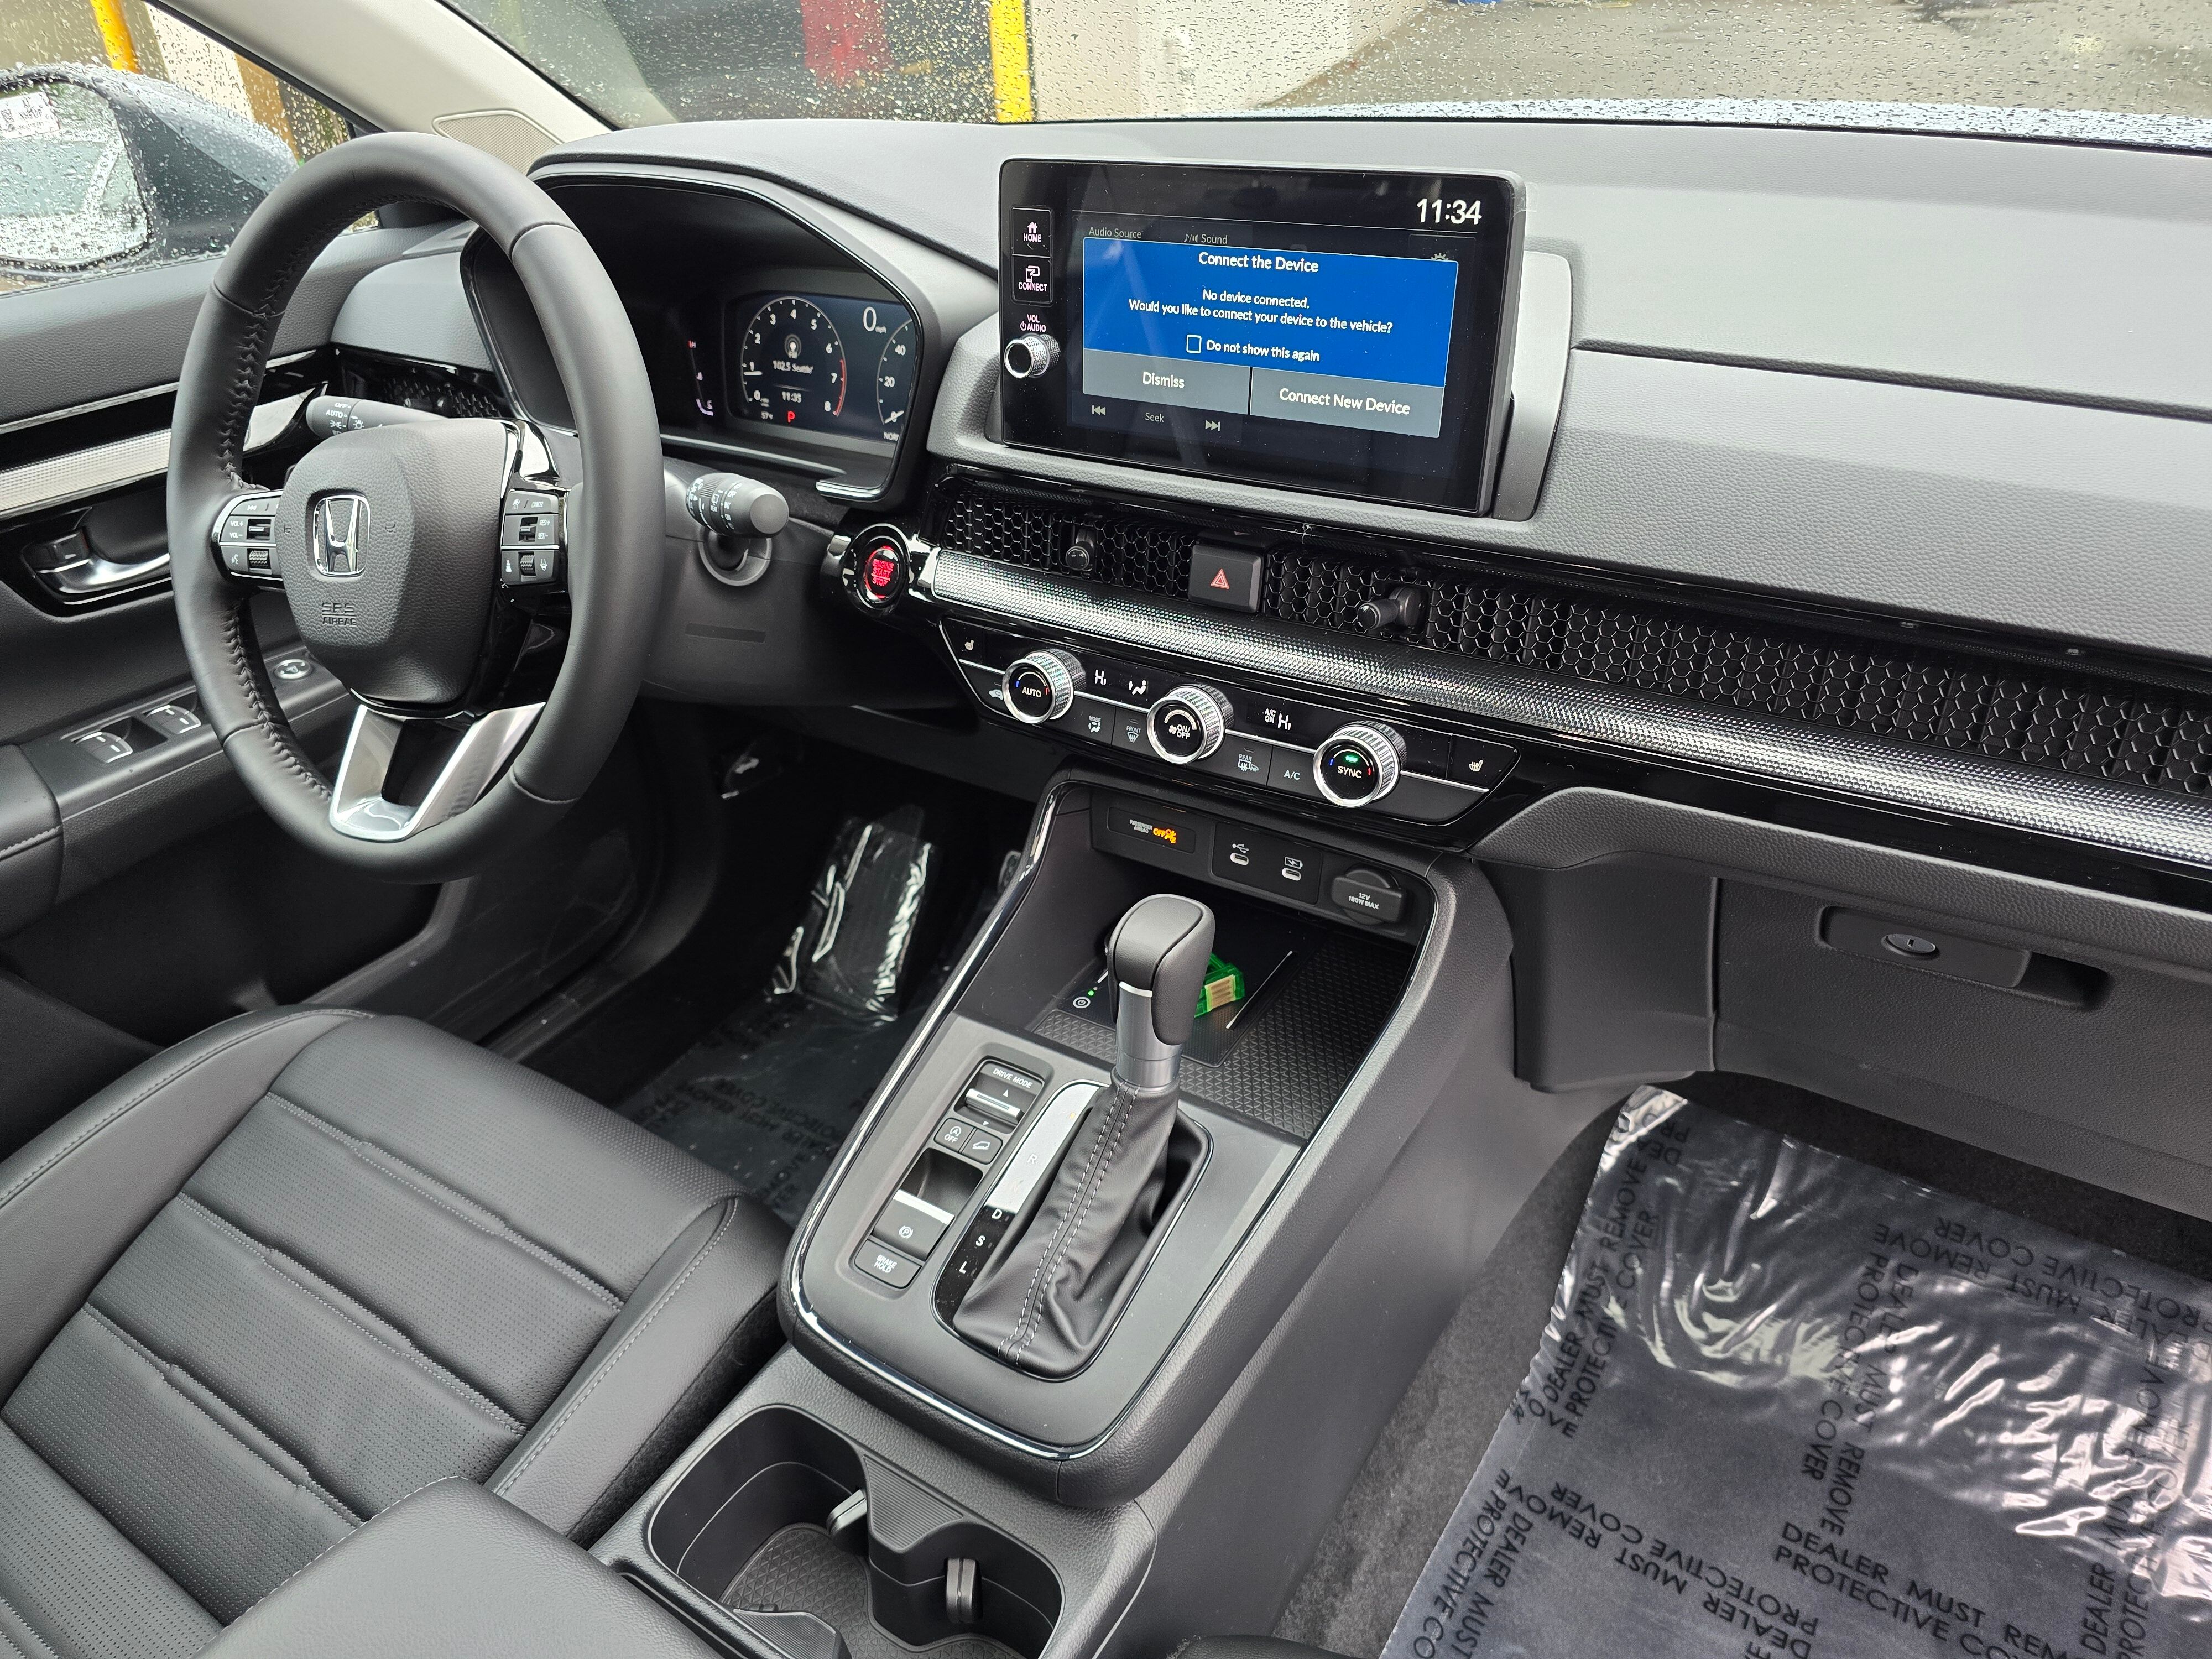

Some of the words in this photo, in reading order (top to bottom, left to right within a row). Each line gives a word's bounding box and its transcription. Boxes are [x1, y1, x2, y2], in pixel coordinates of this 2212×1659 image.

[1417, 199, 1482, 225] 11:34
[1023, 233, 1042, 243] HOME
[1088, 226, 1112, 237] Audio
[1114, 228, 1142, 239] Source
[1201, 234, 1228, 245] Sound
[1198, 252, 1249, 268] Connect
[1251, 256, 1272, 270] the
[1275, 257, 1319, 273] Device
[1018, 281, 1048, 293] CONNECT
[1202, 289, 1218, 301] No
[1219, 290, 1252, 304] device
[1253, 295, 1310, 309] connected.
[770, 314, 776, 325] 3
[790, 309, 797, 320] 4
[863, 306, 877, 333] 0
[1026, 314, 1040, 324] VOL
[1129, 299, 1160, 313] Would
[1161, 304, 1180, 316] you
[1181, 304, 1198, 316] like
[1200, 306, 1211, 317] to
[1212, 309, 1253, 321] connect
[1254, 314, 1279, 325] your
[1280, 313, 1313, 327] device
[1315, 316, 1327, 327] to
[1329, 317, 1347, 330] the
[1349, 319, 1394, 333] vehicle?
[811, 319, 817, 330] 5
[1026, 323, 1046, 332] AUDIO
[754, 333, 761, 344] 2
[826, 343, 832, 354] 6
[895, 345, 906, 356] 40
[1207, 339, 1222, 352] Do
[1223, 343, 1240, 354] not
[1242, 343, 1269, 357] show
[1271, 346, 1290, 359] this
[1292, 349, 1321, 362] again
[749, 361, 754, 371] 1
[831, 373, 837, 384] 7
[884, 376, 895, 388] 20
[1142, 371, 1185, 388] Dismiss
[754, 390, 760, 400] 0
[1279, 388, 1331, 406] Connect
[1333, 394, 1363, 410] New
[1365, 397, 1410, 415] Device
[824, 401, 831, 412] 8
[326, 409, 343, 418] AUTO
[787, 410, 795, 423] P
[1145, 412, 1164, 424] Seek
[873, 559, 894, 571] ENGINE
[872, 567, 891, 578] START
[872, 577, 889, 587] STOP
[1021, 686, 1041, 698] AUTO
[1088, 715, 1102, 723] MODE
[1264, 708, 1276, 718] A/C
[1264, 715, 1274, 724] ON
[1126, 725, 1141, 734] FRONT
[1176, 724, 1191, 733] ON/
[1176, 731, 1191, 739] OFF
[1239, 753, 1253, 762] REAR
[1284, 769, 1301, 780] A/C
[1337, 765, 1363, 779] SYNC
[1348, 895, 1364, 905] 180W
[1364, 900, 1380, 910] MAX
[1359, 892, 1371, 900] 12V
[993, 1068, 1013, 1081] DRIVE
[1012, 1076, 1033, 1088] MODE
[944, 1135, 958, 1143] OFF
[991, 1208, 1003, 1220] D
[975, 1235, 986, 1246] S
[1936, 1217, 2034, 1267] COVER
[1874, 1223, 1991, 1277] REMOVE
[874, 1261, 893, 1274] HOLD
[877, 1254, 897, 1269] BRAKE
[959, 1260, 967, 1274] L
[1542, 1331, 1584, 1403] DEALER
[1574, 1260, 1608, 1326] MUST
[1601, 1157, 1649, 1253] REMOVE
[2008, 1274, 2083, 1314] MUST
[1564, 1298, 1629, 1421] PROTECTIVE
[1615, 1209, 1660, 1290] COVER
[1856, 1363, 1887, 1432] MUST
[1801, 1399, 1844, 1482] COVER
[1820, 1442, 1865, 1537] REMOVE
[1495, 1468, 1603, 1549] REMOVE
[1550, 1481, 1644, 1545] COVER
[1433, 1490, 1507, 1619] PROTECTIVE
[1483, 1511, 1533, 1588] DEALER
[1614, 1547, 1688, 1595] MUST
[1781, 1521, 1890, 1585] DEALER
[1906, 1579, 1986, 1629] MUST
[1649, 1537, 1819, 1637] PROTECTIVE
[1774, 1544, 1951, 1642] PROTECTIVE
[2078, 1561, 2117, 1656] DEALER
[1451, 1590, 1495, 1659] MUST
[1702, 1592, 1813, 1659] DEALER
